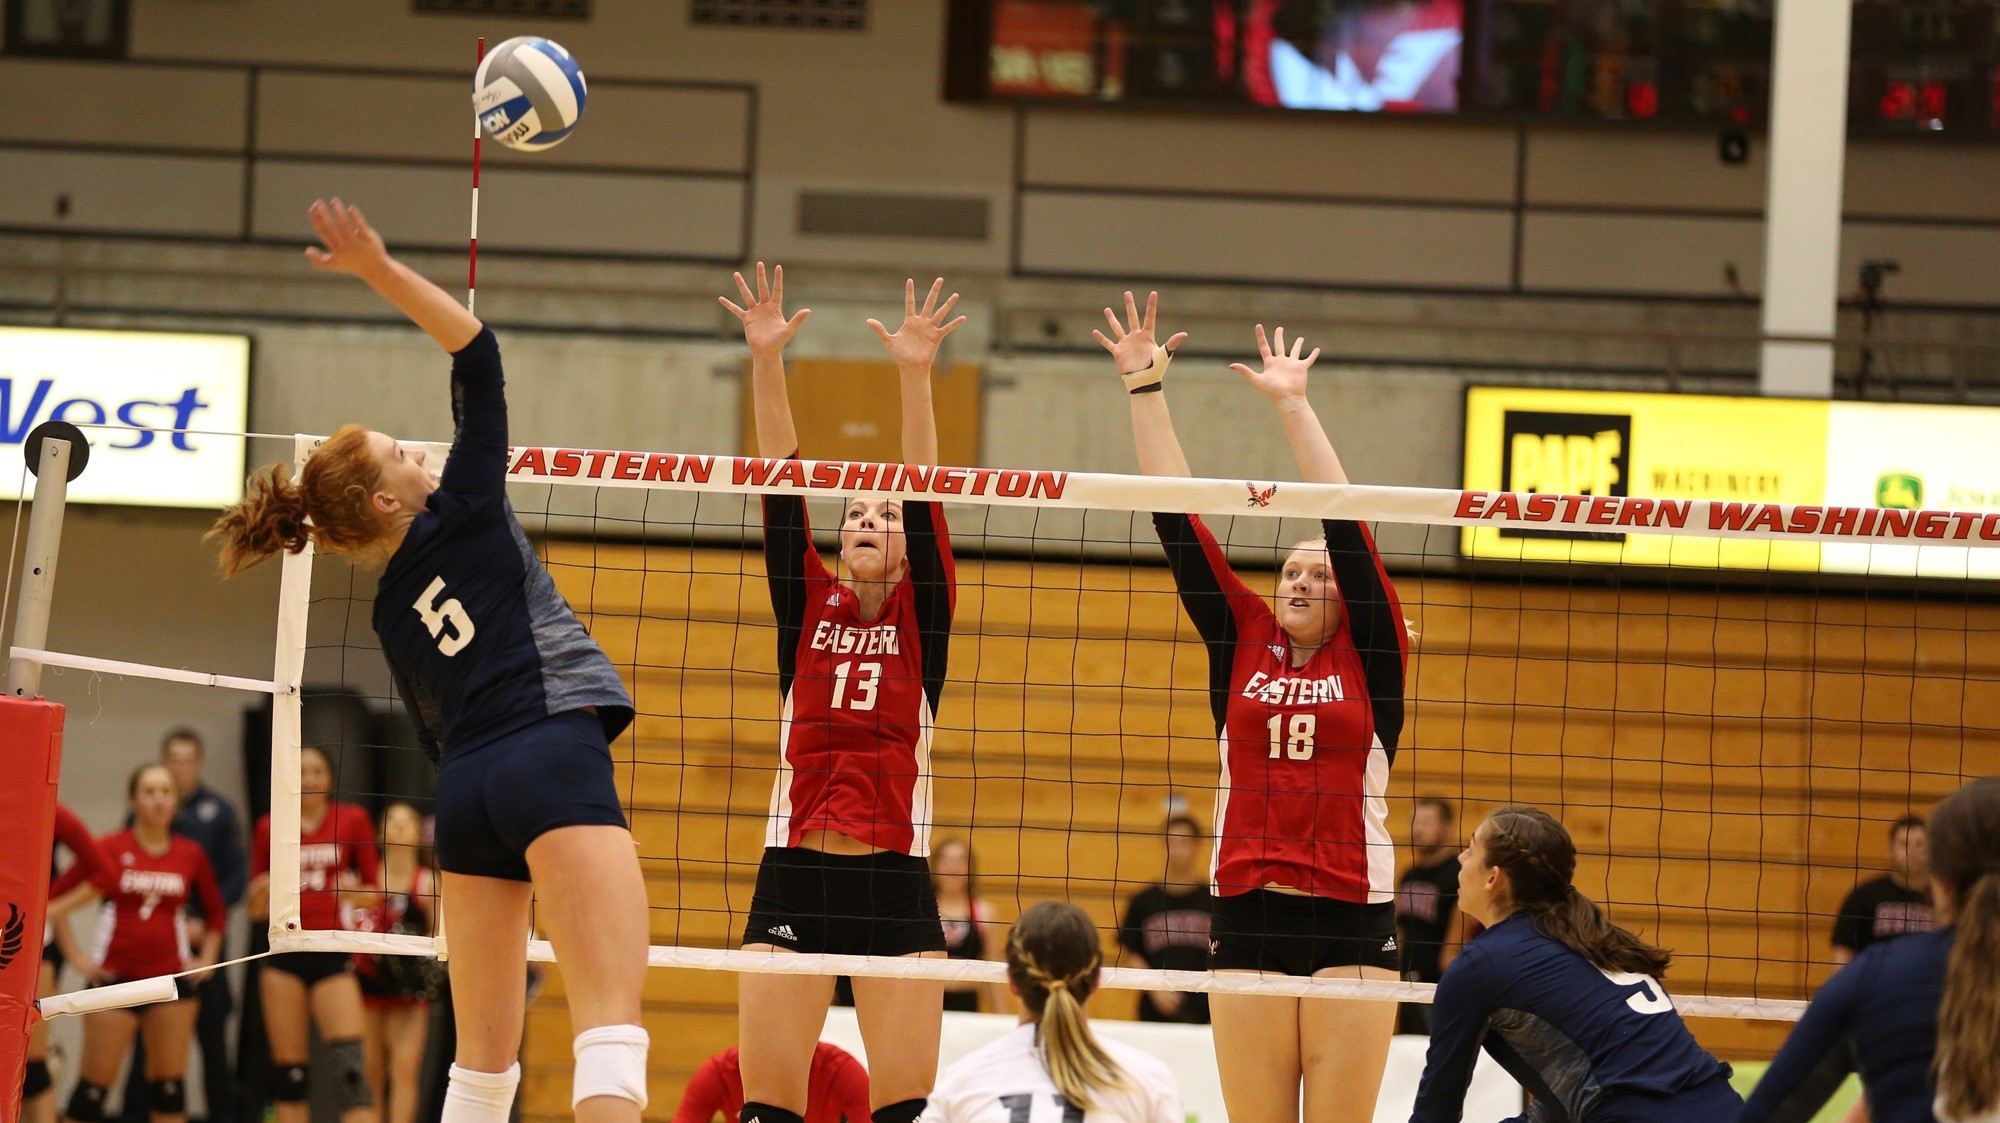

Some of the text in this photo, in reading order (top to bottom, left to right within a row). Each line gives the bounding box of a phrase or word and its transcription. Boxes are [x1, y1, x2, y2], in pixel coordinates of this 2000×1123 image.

[732, 457, 1069, 500] WASHINGTON
[1454, 490, 1692, 528] EASTERN
[412, 575, 475, 657] 5
[831, 661, 882, 711] 13
[1242, 671, 1344, 705] EASTERN
[1267, 713, 1316, 761] 18
